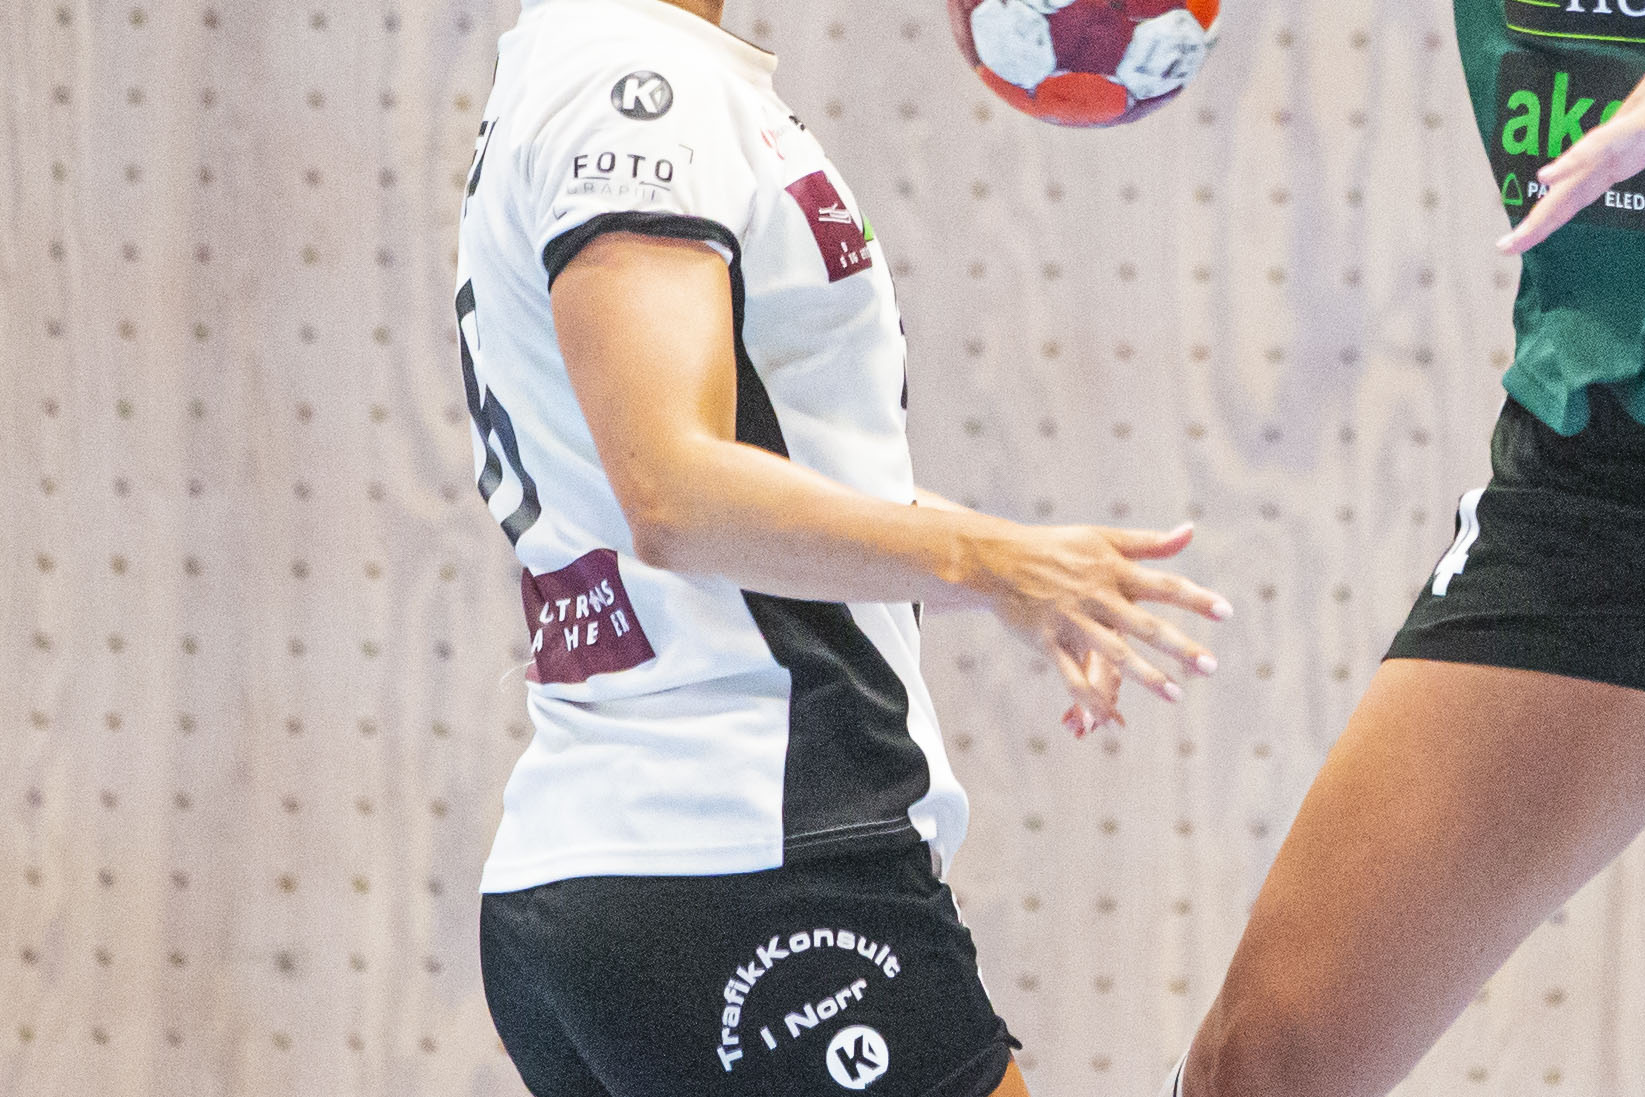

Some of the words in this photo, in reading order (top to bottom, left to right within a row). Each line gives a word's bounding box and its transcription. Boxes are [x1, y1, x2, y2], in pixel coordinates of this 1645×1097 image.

[573, 151, 673, 183] FOTO
[717, 928, 900, 1072] TrafikKonsult
[760, 1025, 777, 1051] I
[784, 978, 868, 1039] Norr
